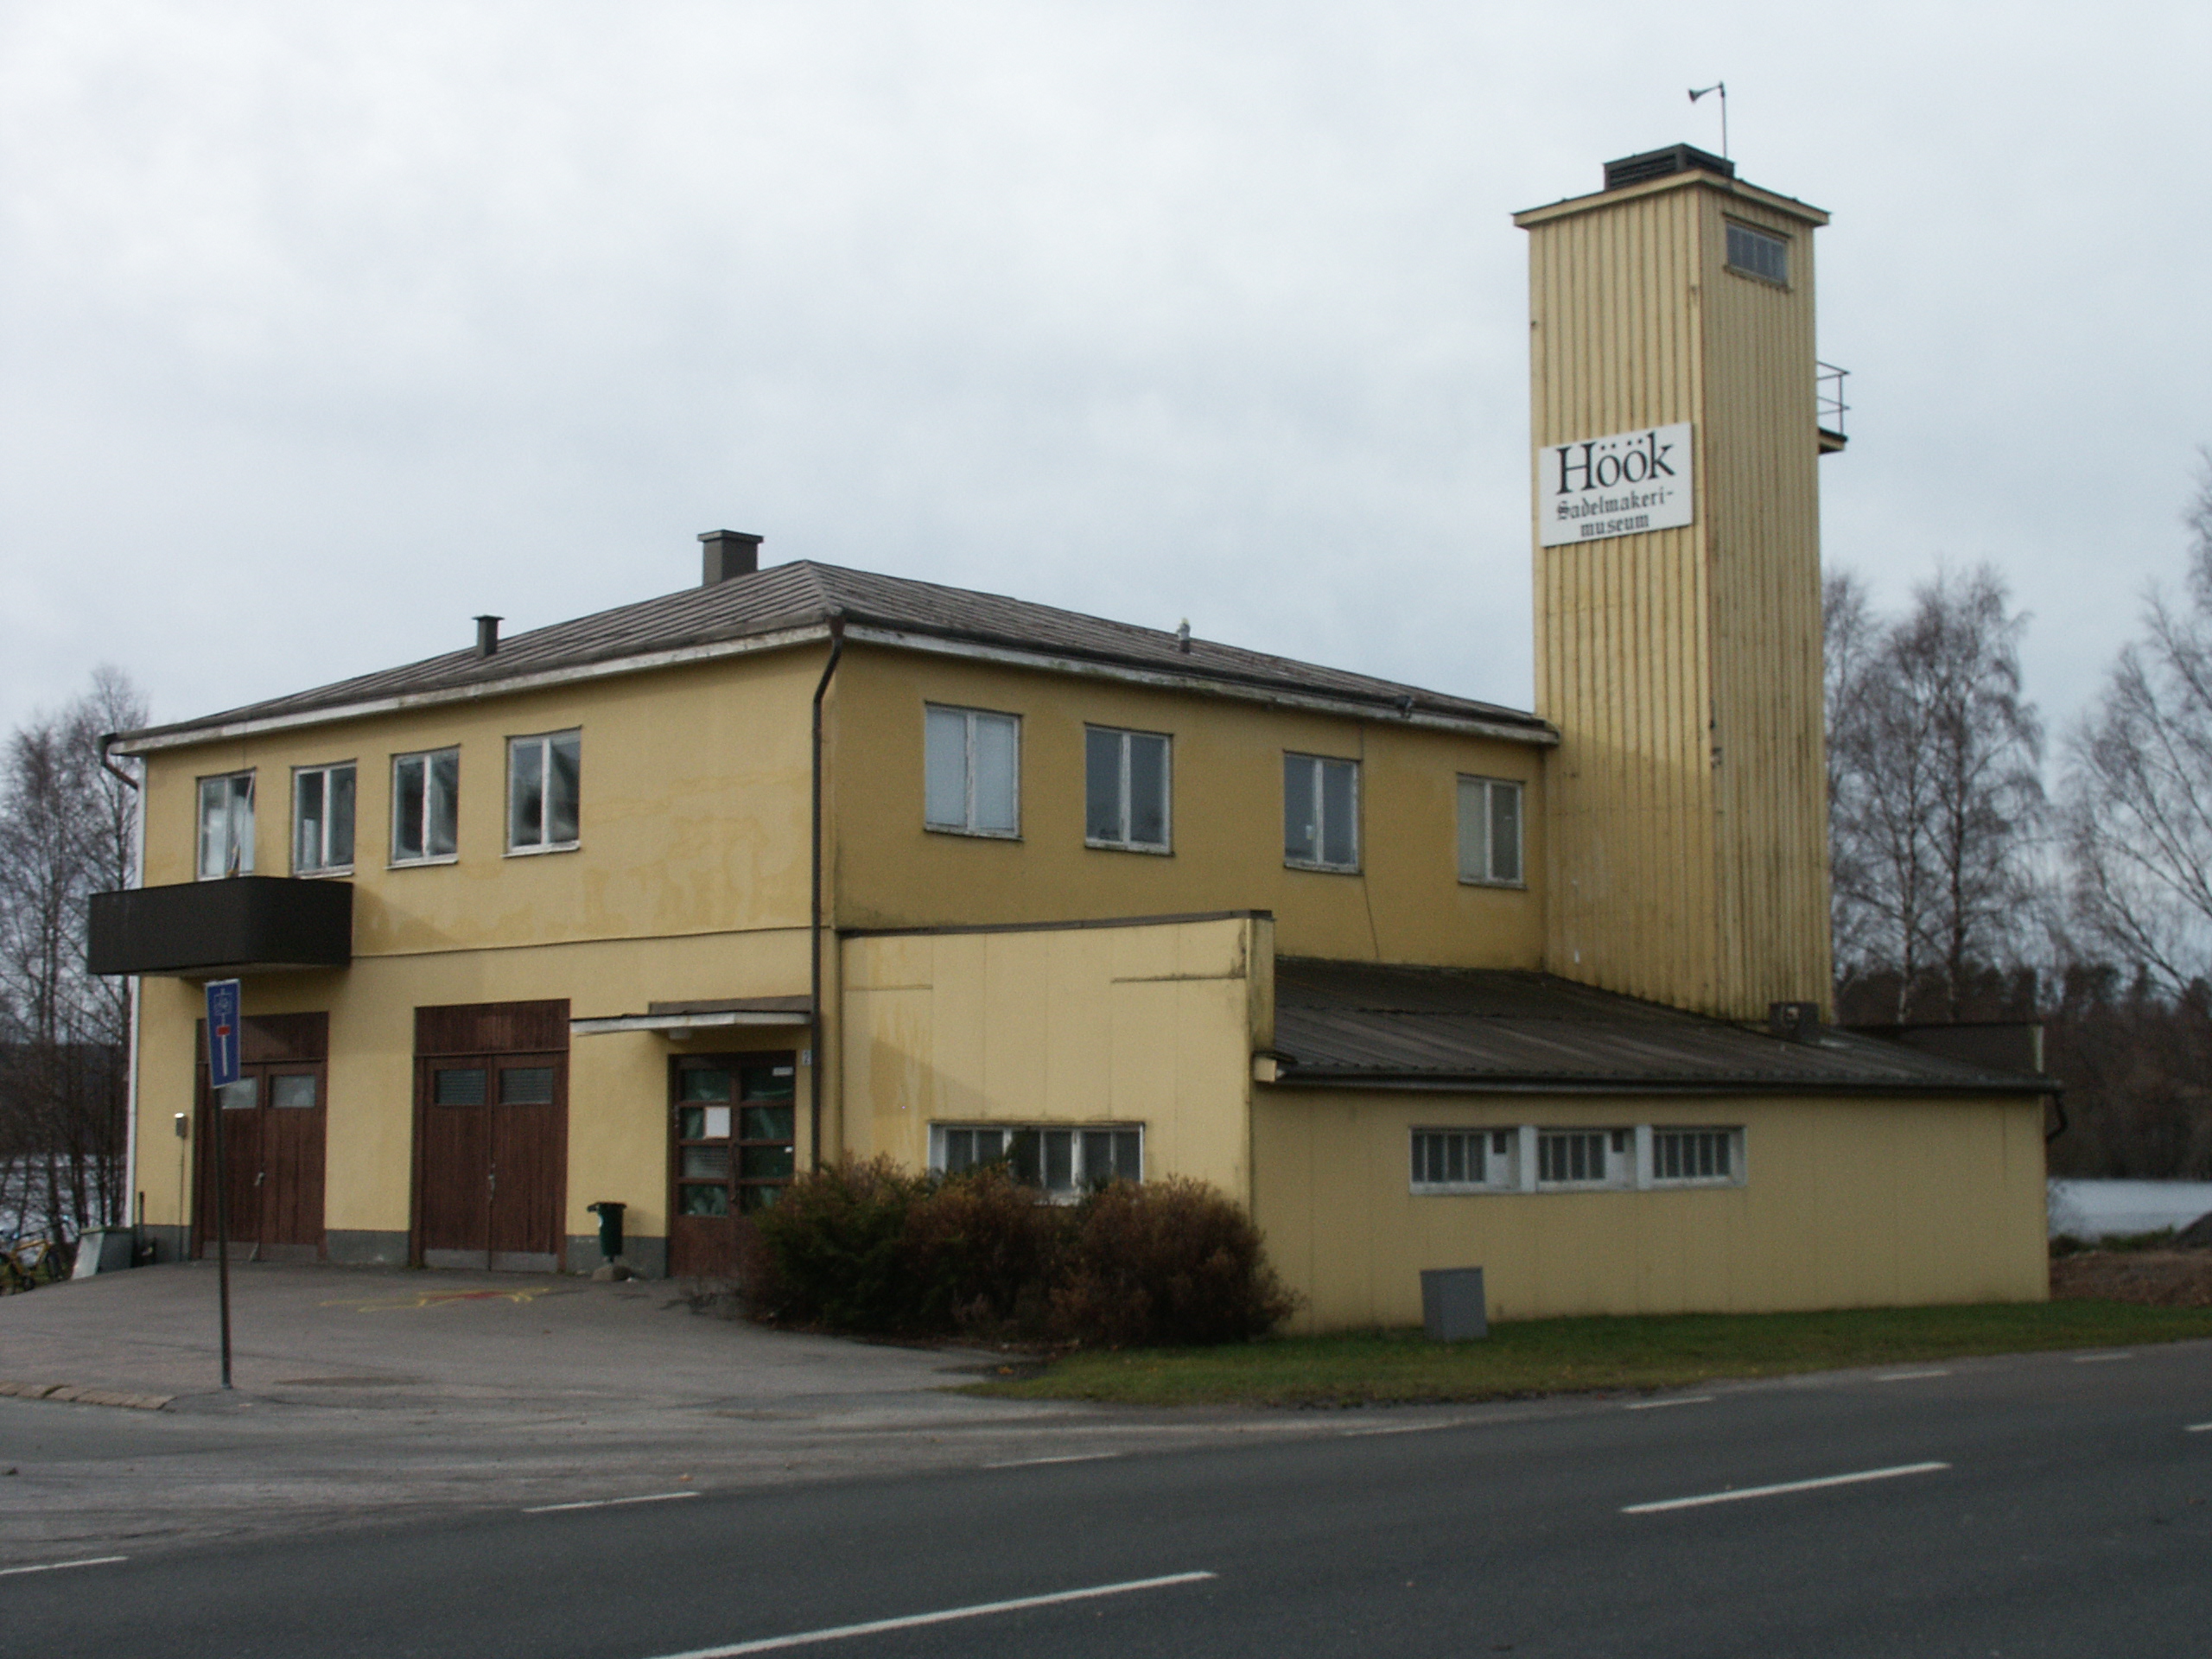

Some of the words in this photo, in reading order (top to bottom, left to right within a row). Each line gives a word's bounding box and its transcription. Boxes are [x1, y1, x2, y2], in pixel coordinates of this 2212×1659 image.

[1556, 430, 1676, 495] Höök
[1557, 486, 1674, 520] Sadelmakeri-
[1580, 514, 1649, 537] museum
